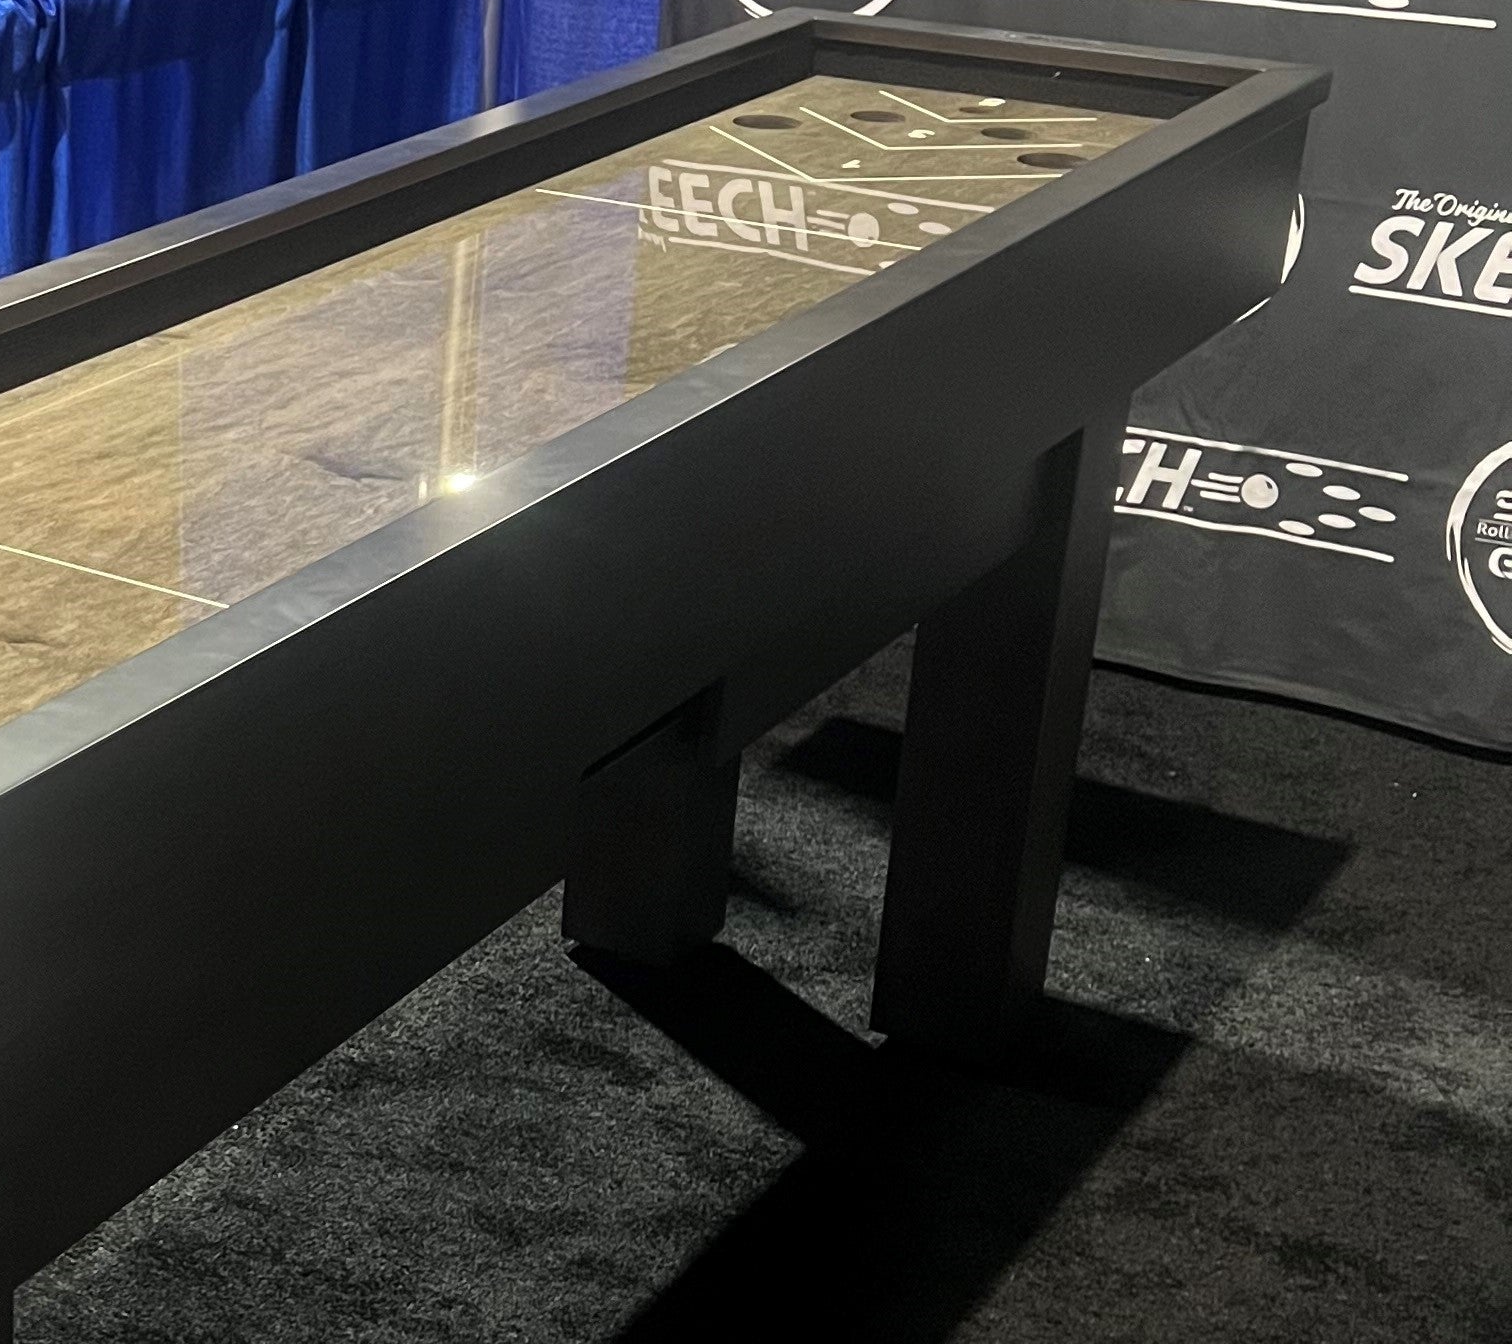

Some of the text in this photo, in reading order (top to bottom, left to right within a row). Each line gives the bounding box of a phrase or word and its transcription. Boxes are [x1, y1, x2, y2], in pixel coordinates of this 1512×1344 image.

[1391, 188, 1512, 227] The Origin
[1353, 215, 1512, 304] SKE
